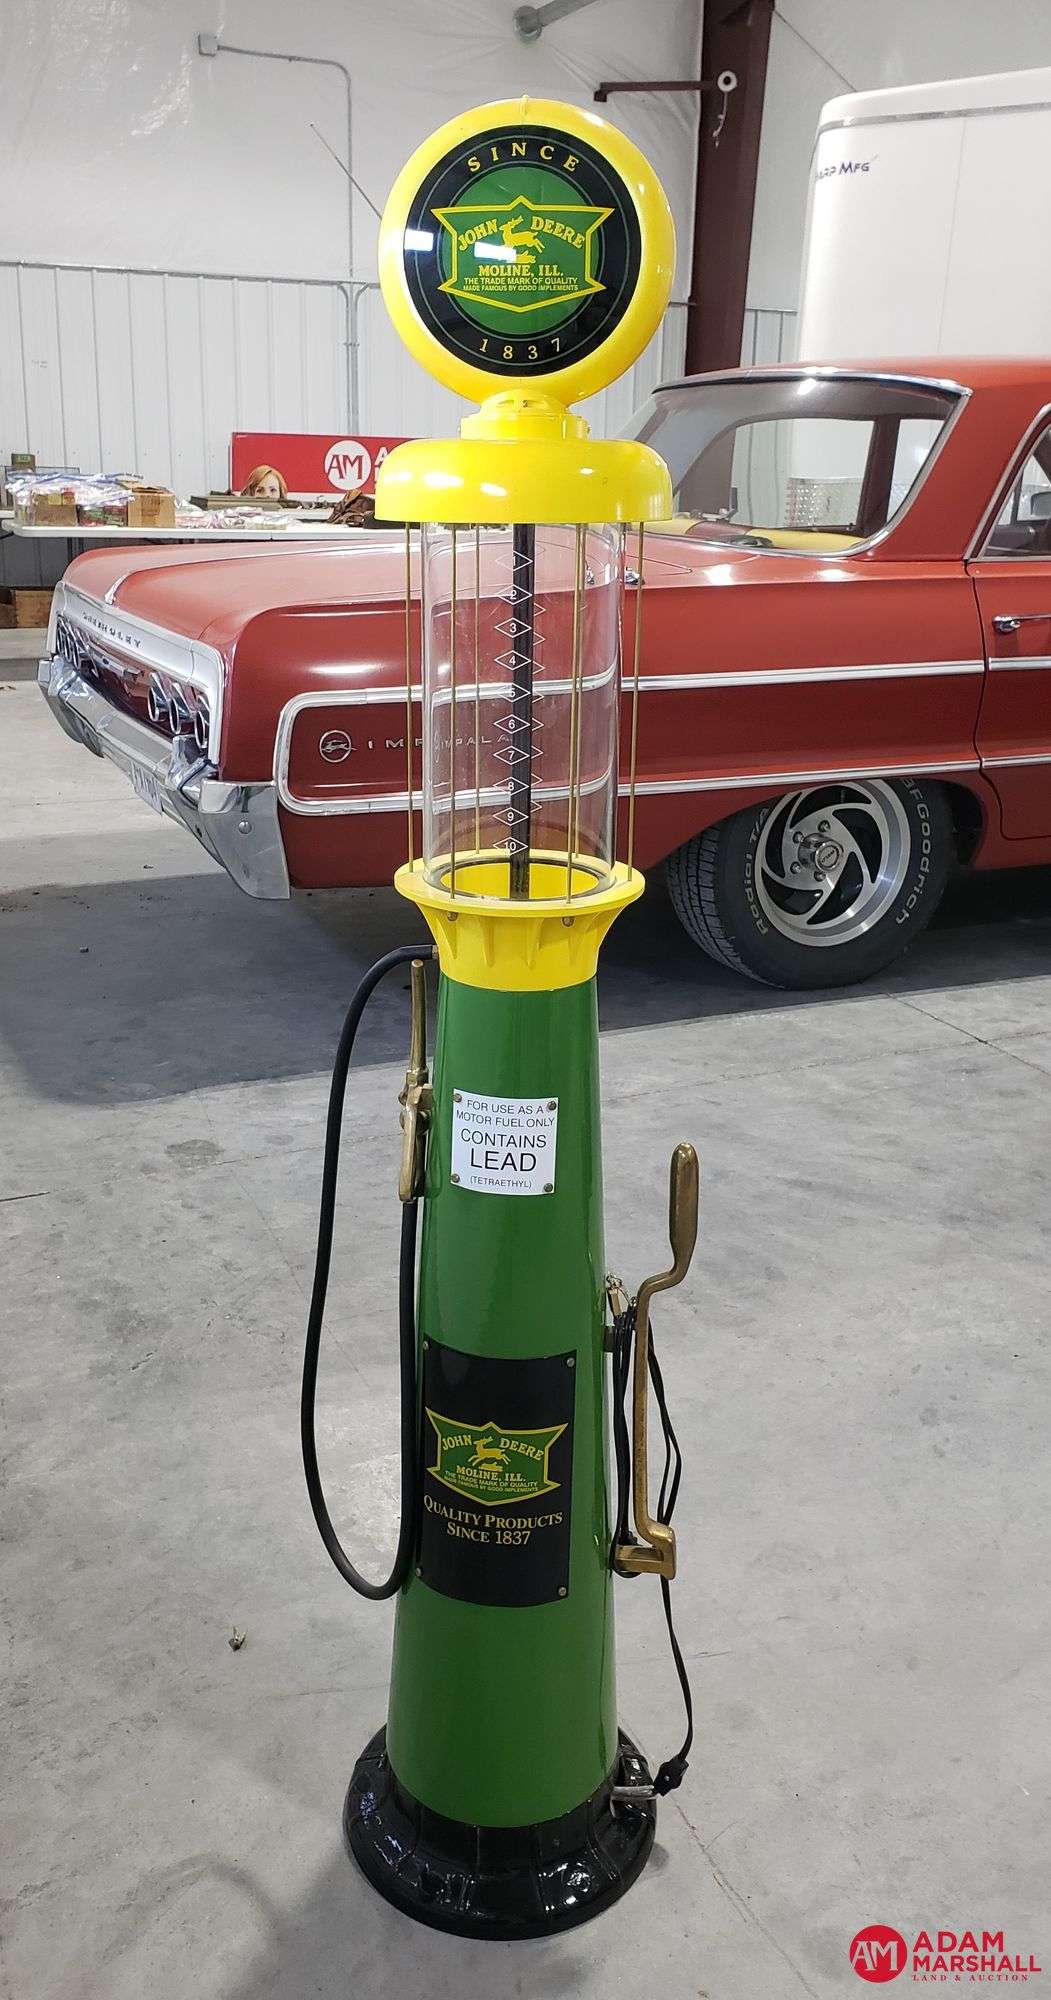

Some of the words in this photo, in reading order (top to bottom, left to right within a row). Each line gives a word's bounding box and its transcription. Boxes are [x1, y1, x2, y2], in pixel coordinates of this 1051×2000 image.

[467, 142, 580, 173] SINCE
[838, 161, 870, 175] MFG
[457, 218, 498, 251] JOHN
[530, 216, 586, 249] DEERE
[478, 265, 534, 278] MOLINE,
[538, 265, 564, 277] ILL.
[464, 277, 480, 285] THE
[481, 277, 506, 285] TRADE
[508, 277, 531, 285] MARK
[532, 277, 543, 285] OF
[544, 277, 578, 285] QUALITY
[479, 338, 561, 360] 1837
[328, 454, 364, 480] AM
[509, 623, 517, 633] 3
[508, 655, 516, 666] 4
[508, 719, 515, 730] 6
[508, 750, 515, 761] 7
[508, 781, 515, 791] 8
[507, 811, 514, 822] 9
[505, 841, 517, 852] 10
[744, 850, 769, 935] Radial
[467, 1099, 489, 1112] FOR
[491, 1104, 515, 1115] USE
[517, 1105, 533, 1115] AS
[536, 1105, 544, 1114] A
[456, 1109, 492, 1125] MOTOR
[495, 1117, 525, 1128] FUEL
[526, 1117, 555, 1128] ONLY
[461, 1128, 547, 1148] CONTAINS
[470, 1148, 537, 1172] LEAD
[470, 1176, 532, 1188] (TETRAETHYL)
[441, 1434, 472, 1451] JOHN
[499, 1437, 545, 1461] DEERE
[456, 1465, 502, 1482] MOLINE,
[505, 1473, 526, 1482] ILL.
[424, 1494, 482, 1526] QUALITY
[485, 1511, 563, 1529] PRODUCTS
[447, 1521, 490, 1543] SINCE
[495, 1530, 531, 1545] 1837
